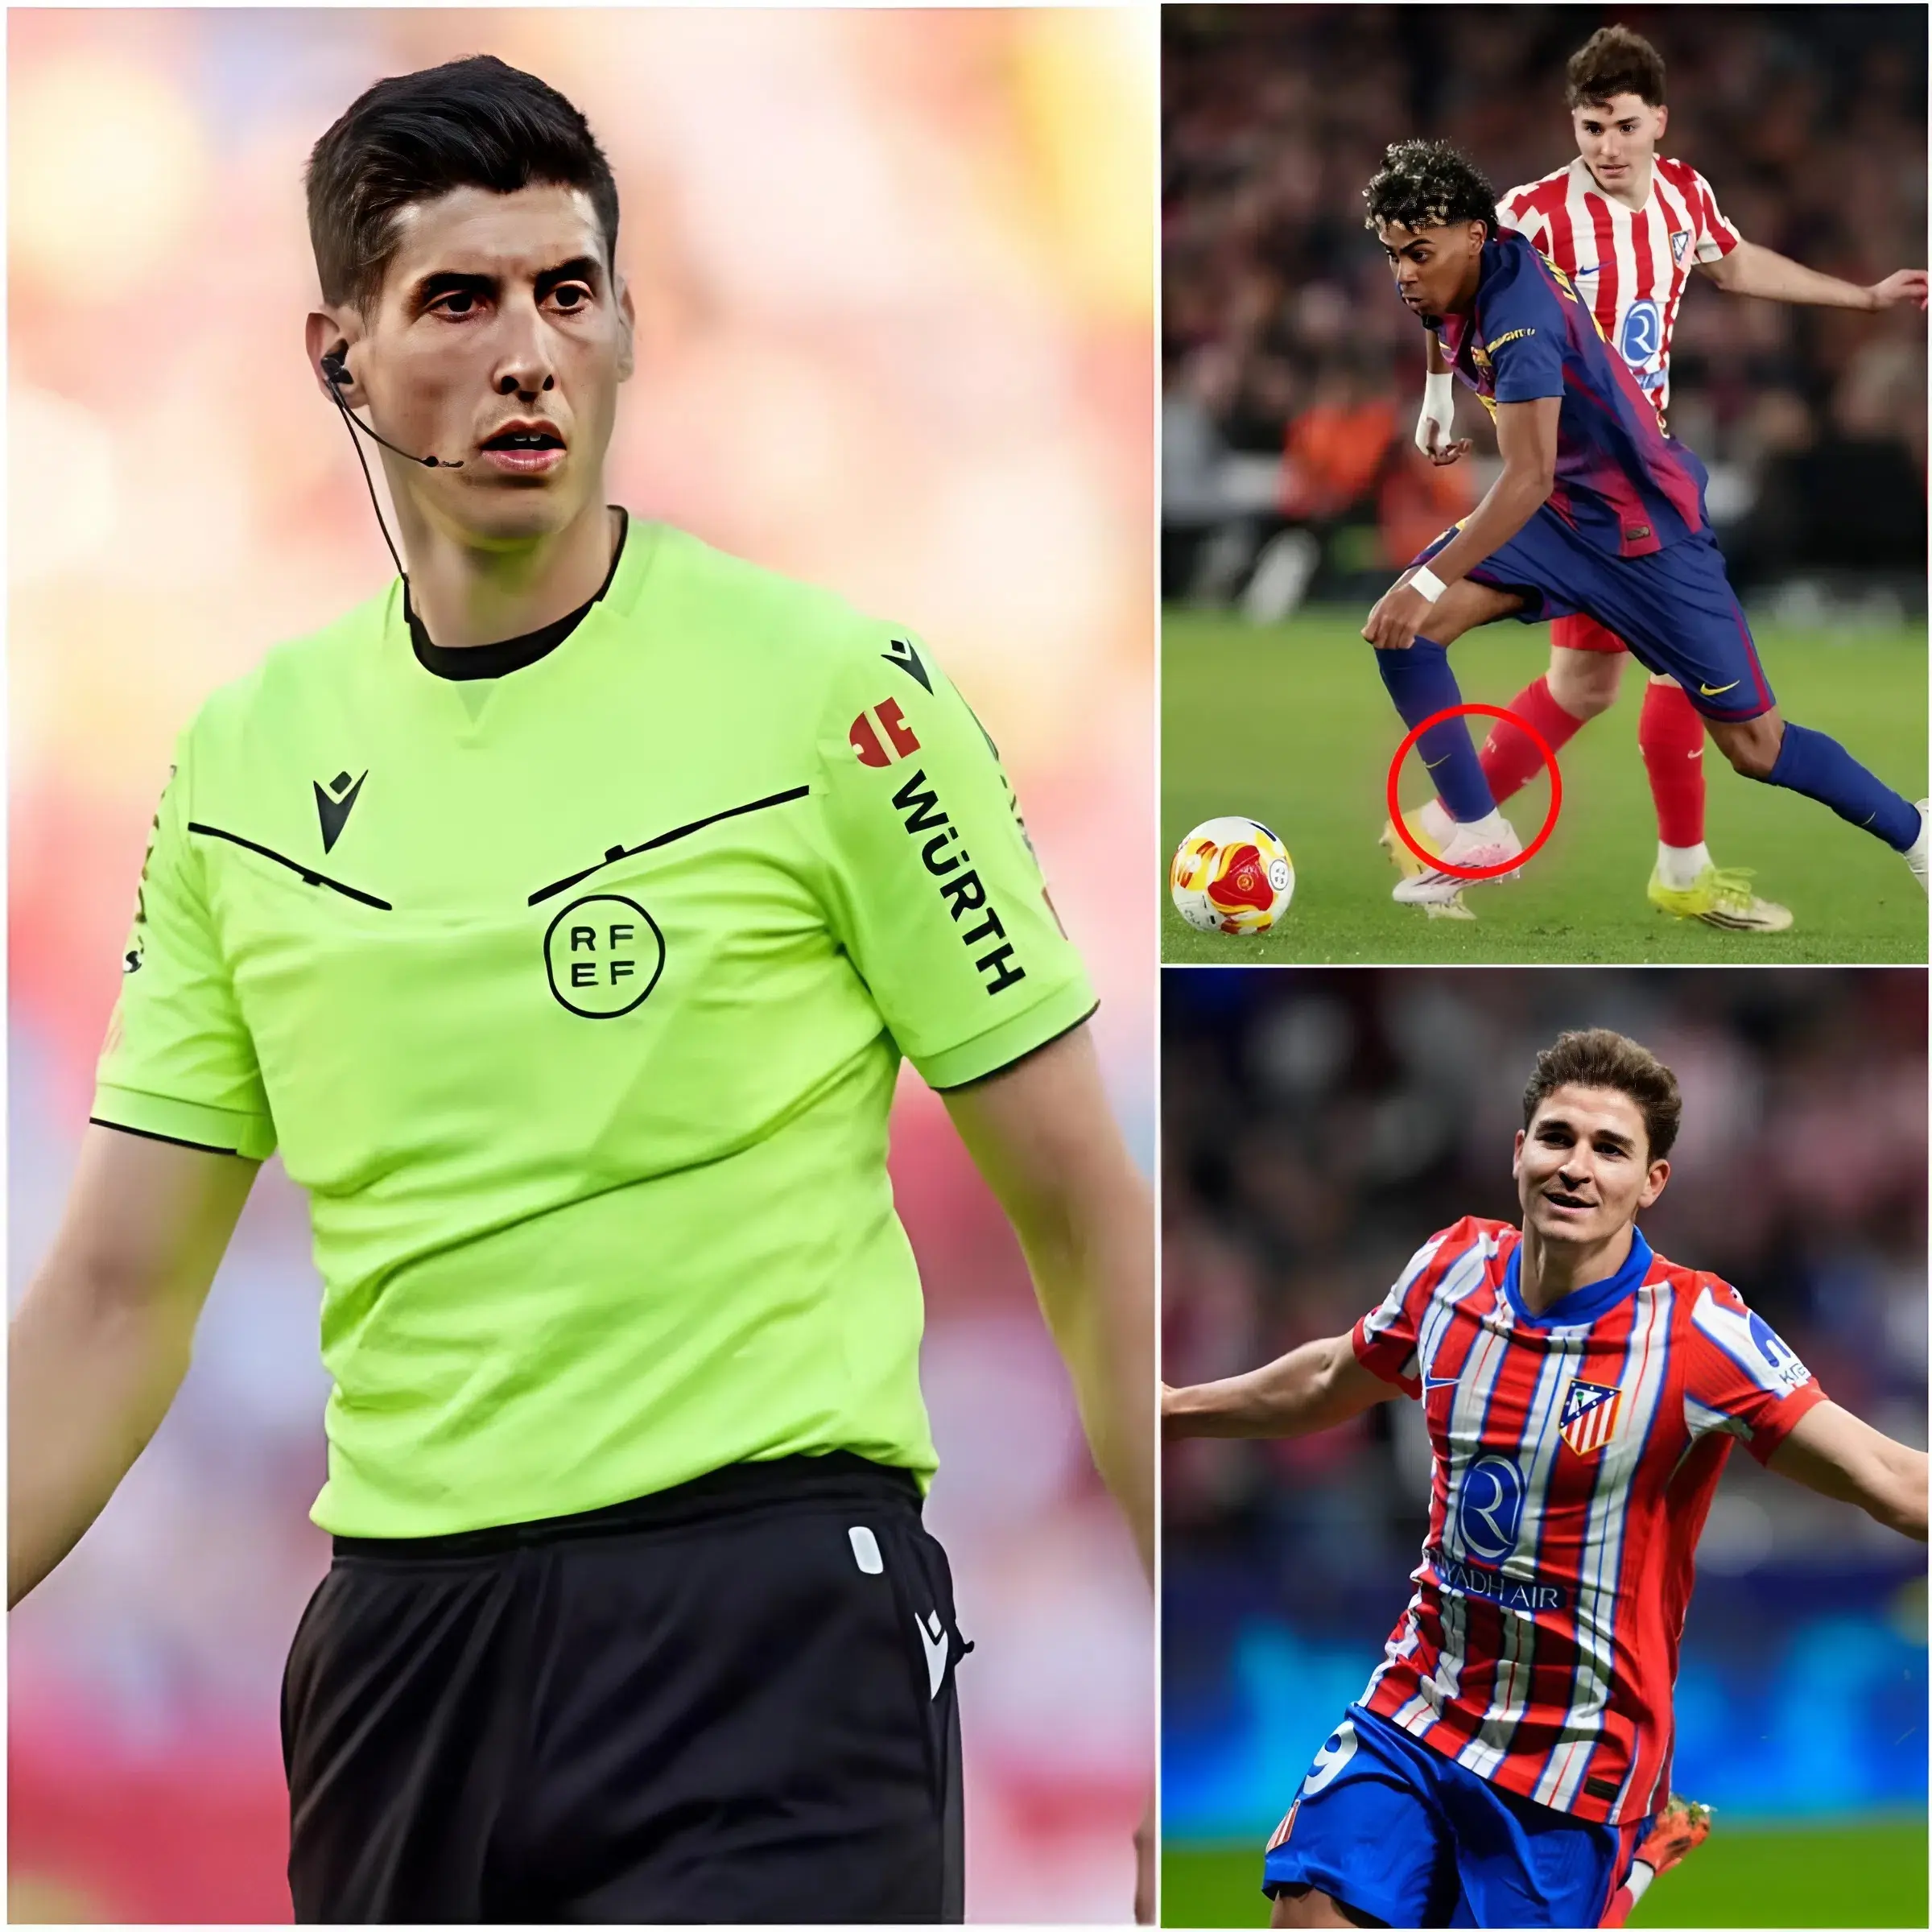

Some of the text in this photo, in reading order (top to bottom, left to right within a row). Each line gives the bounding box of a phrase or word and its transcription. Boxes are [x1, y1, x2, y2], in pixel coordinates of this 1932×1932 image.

[891, 769, 1026, 996] WÜRTH
[1510, 1584, 1558, 1608] AIR
[1302, 1719, 1359, 1795] 9
